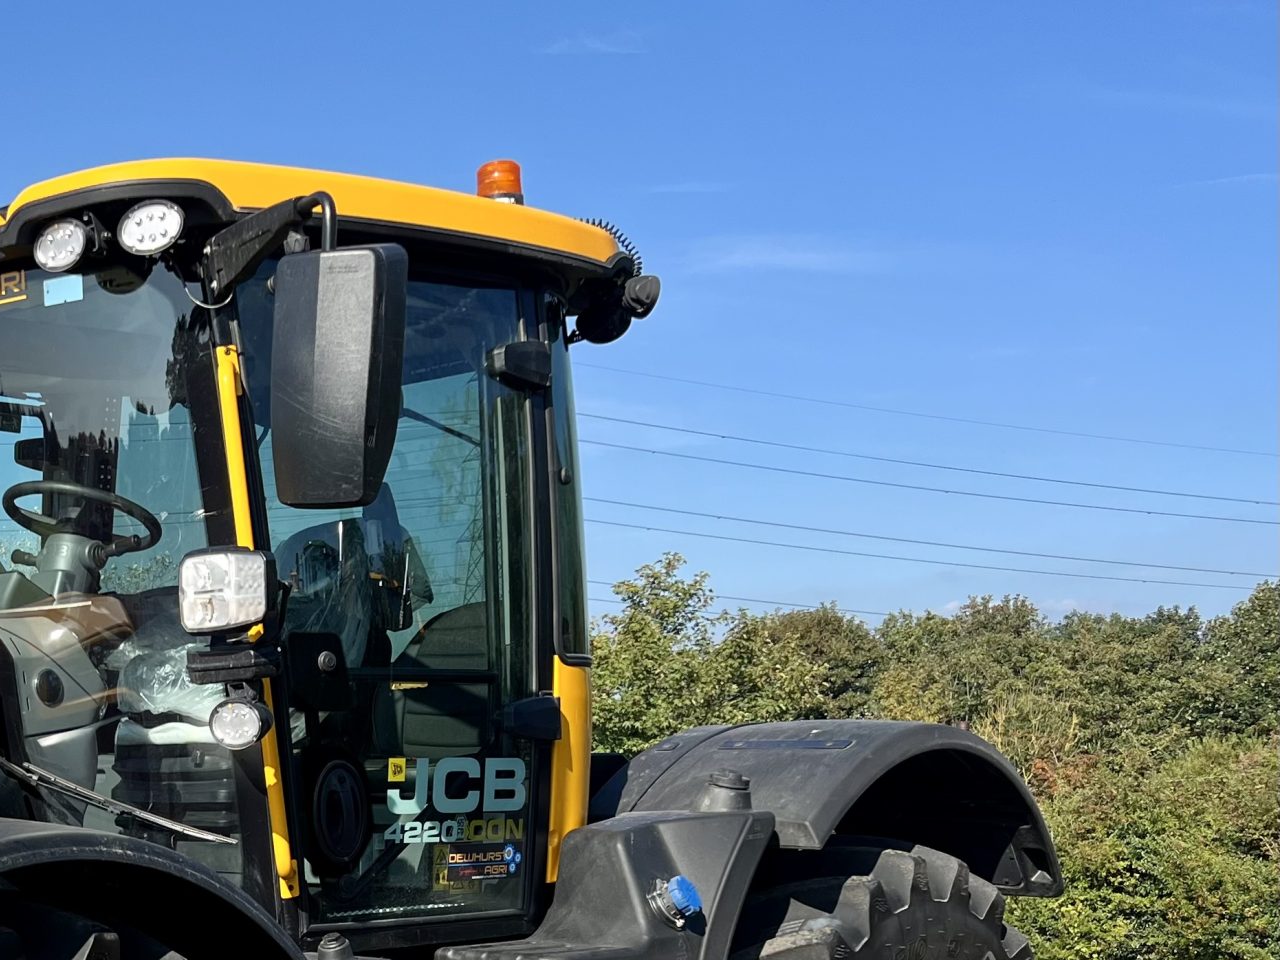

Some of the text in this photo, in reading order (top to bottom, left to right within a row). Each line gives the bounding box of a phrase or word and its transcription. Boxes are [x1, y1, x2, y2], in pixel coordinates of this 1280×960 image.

[387, 757, 526, 815] JCB
[384, 819, 458, 844] 4220
[484, 864, 508, 875] AGRI
